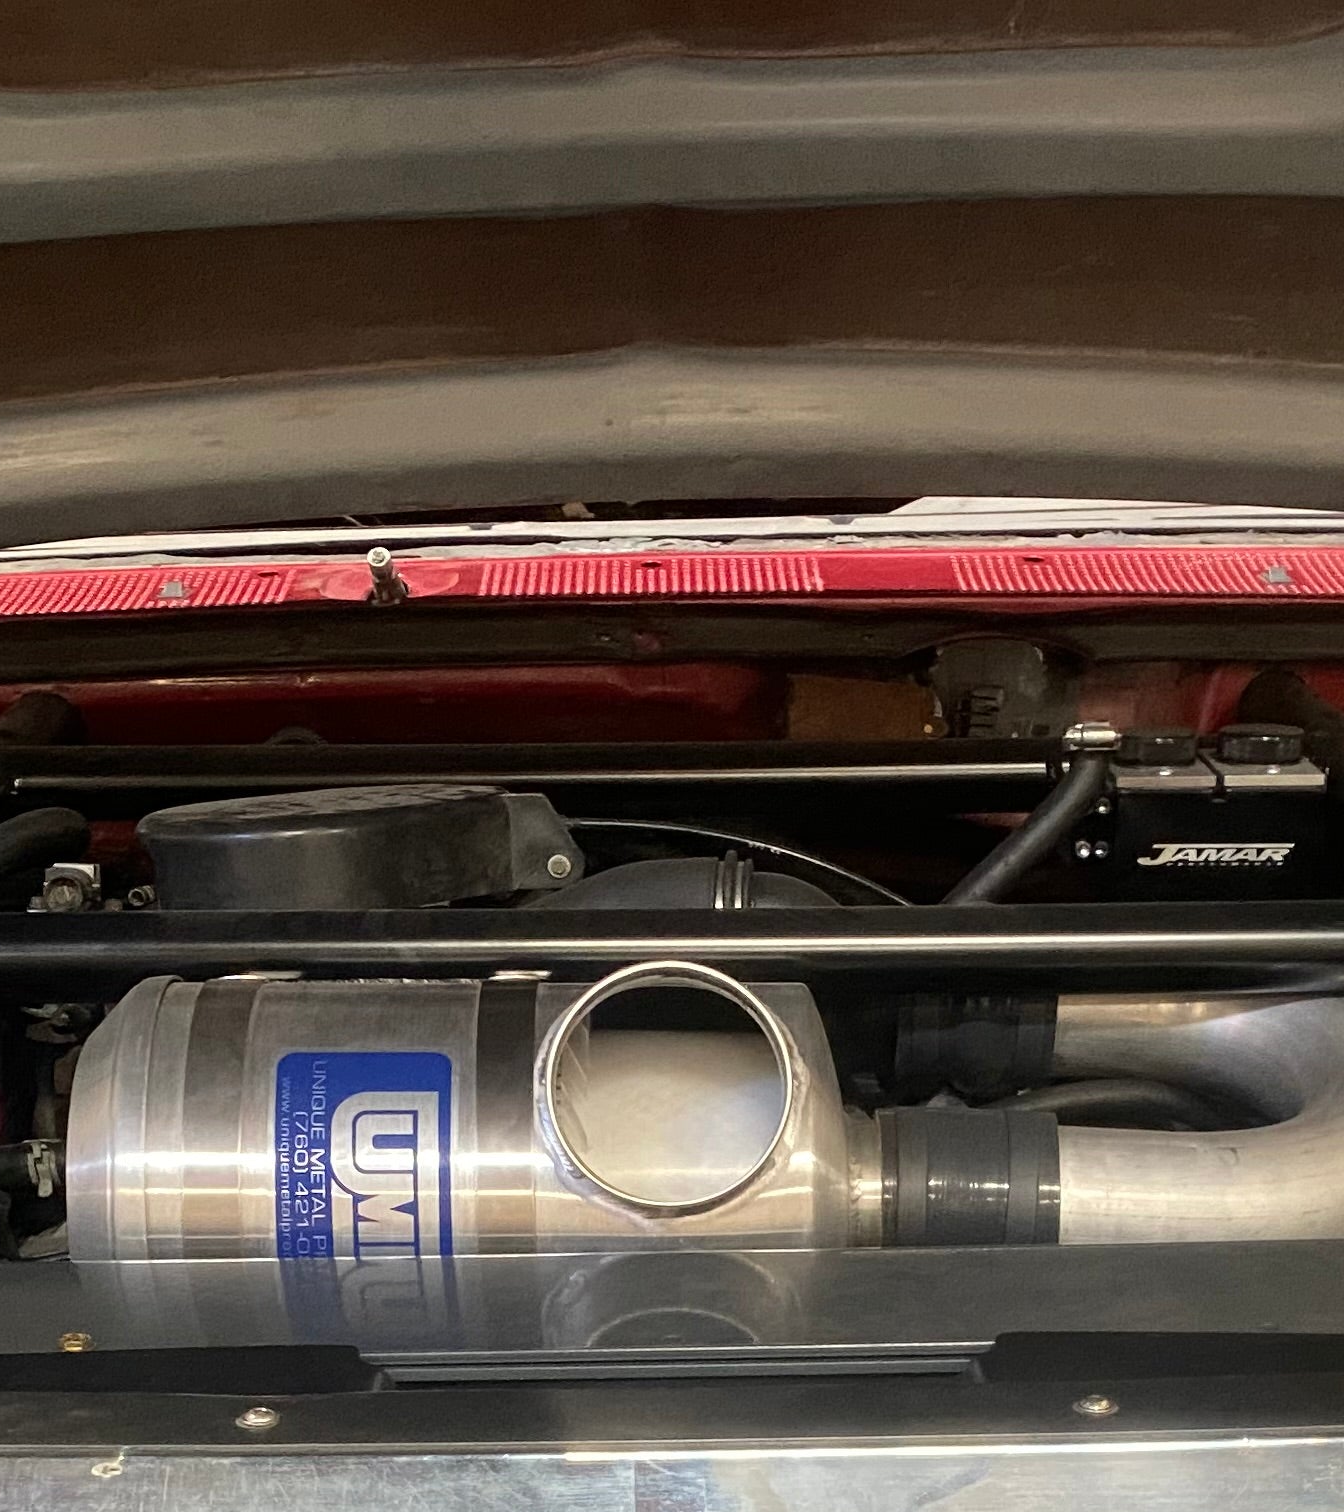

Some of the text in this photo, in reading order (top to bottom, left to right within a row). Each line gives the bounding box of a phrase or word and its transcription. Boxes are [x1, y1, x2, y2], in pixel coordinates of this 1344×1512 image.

[1137, 843, 1296, 866] JAMAR
[311, 1060, 328, 1140] UNIQUE
[293, 1111, 309, 1173] (760)
[310, 1148, 327, 1226] METAL
